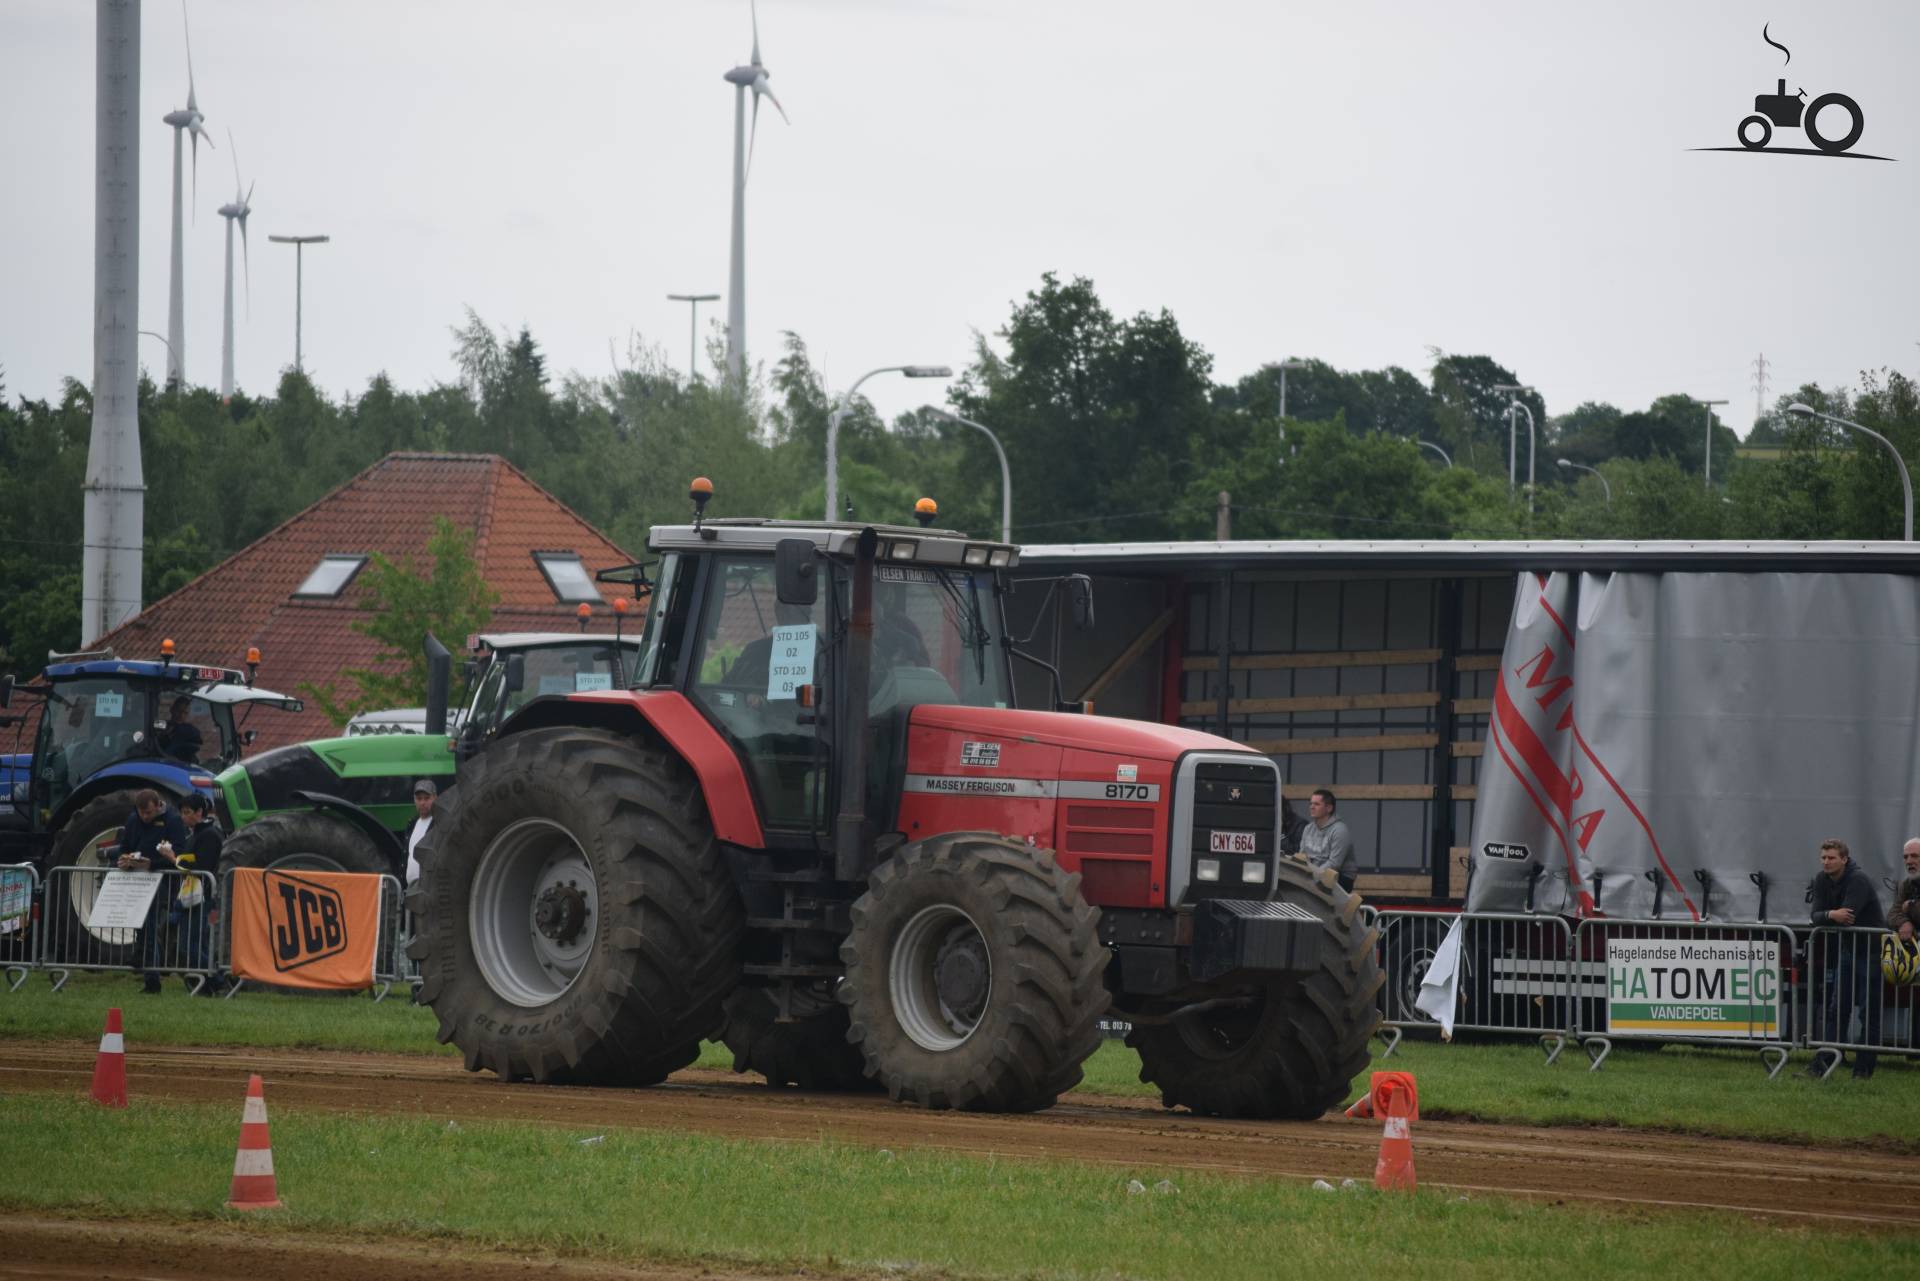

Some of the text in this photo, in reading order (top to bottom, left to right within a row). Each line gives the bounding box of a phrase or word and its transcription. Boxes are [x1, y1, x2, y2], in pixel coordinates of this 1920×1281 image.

[776, 631, 809, 642] STD 105
[786, 647, 798, 658] 02
[773, 666, 807, 676] STD 120
[782, 681, 794, 692] 03
[926, 779, 1016, 793] MASSEY FERGUSON
[1105, 784, 1149, 799] 8170
[277, 881, 341, 961] JCB
[1609, 946, 1775, 963] Hagelandse Mechanisate
[1610, 967, 1777, 1001] HATOMEC
[1650, 1006, 1727, 1021] VANDEPOEL
